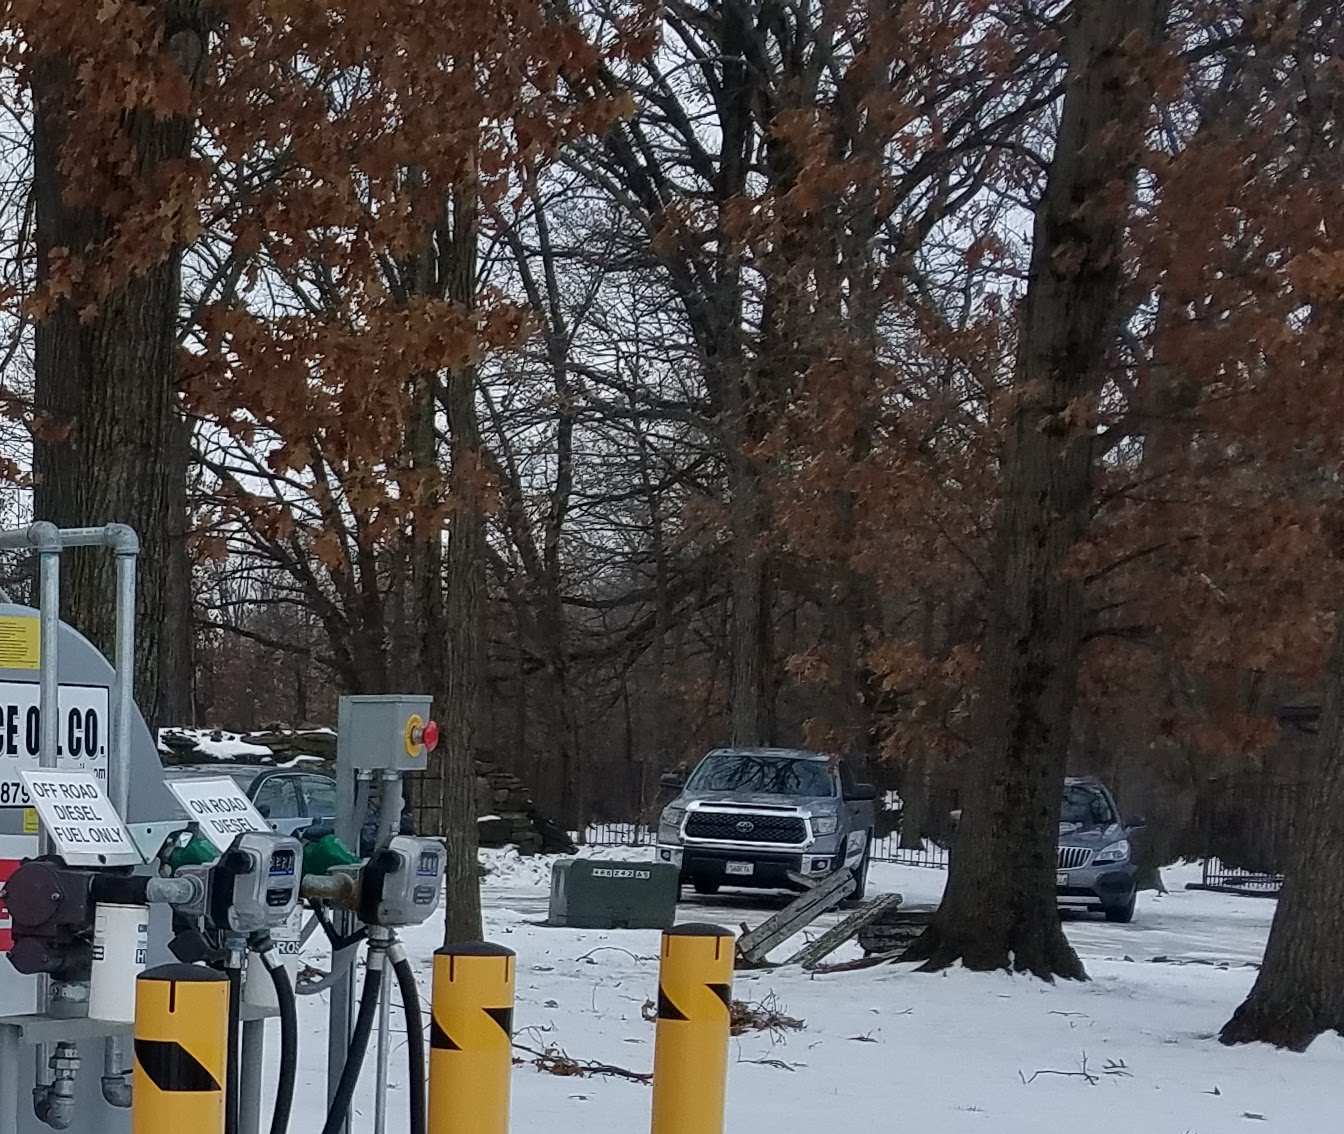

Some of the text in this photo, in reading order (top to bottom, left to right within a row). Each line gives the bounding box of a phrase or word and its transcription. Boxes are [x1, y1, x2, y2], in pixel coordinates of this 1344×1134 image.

[68, 706, 105, 758] CO.
[33, 782, 98, 799] OFF ROAD
[53, 804, 102, 821] DIESEL
[190, 797, 248, 814] ON ROAD
[210, 817, 258, 834] DIESEL
[54, 826, 123, 843] FUEL ONLY
